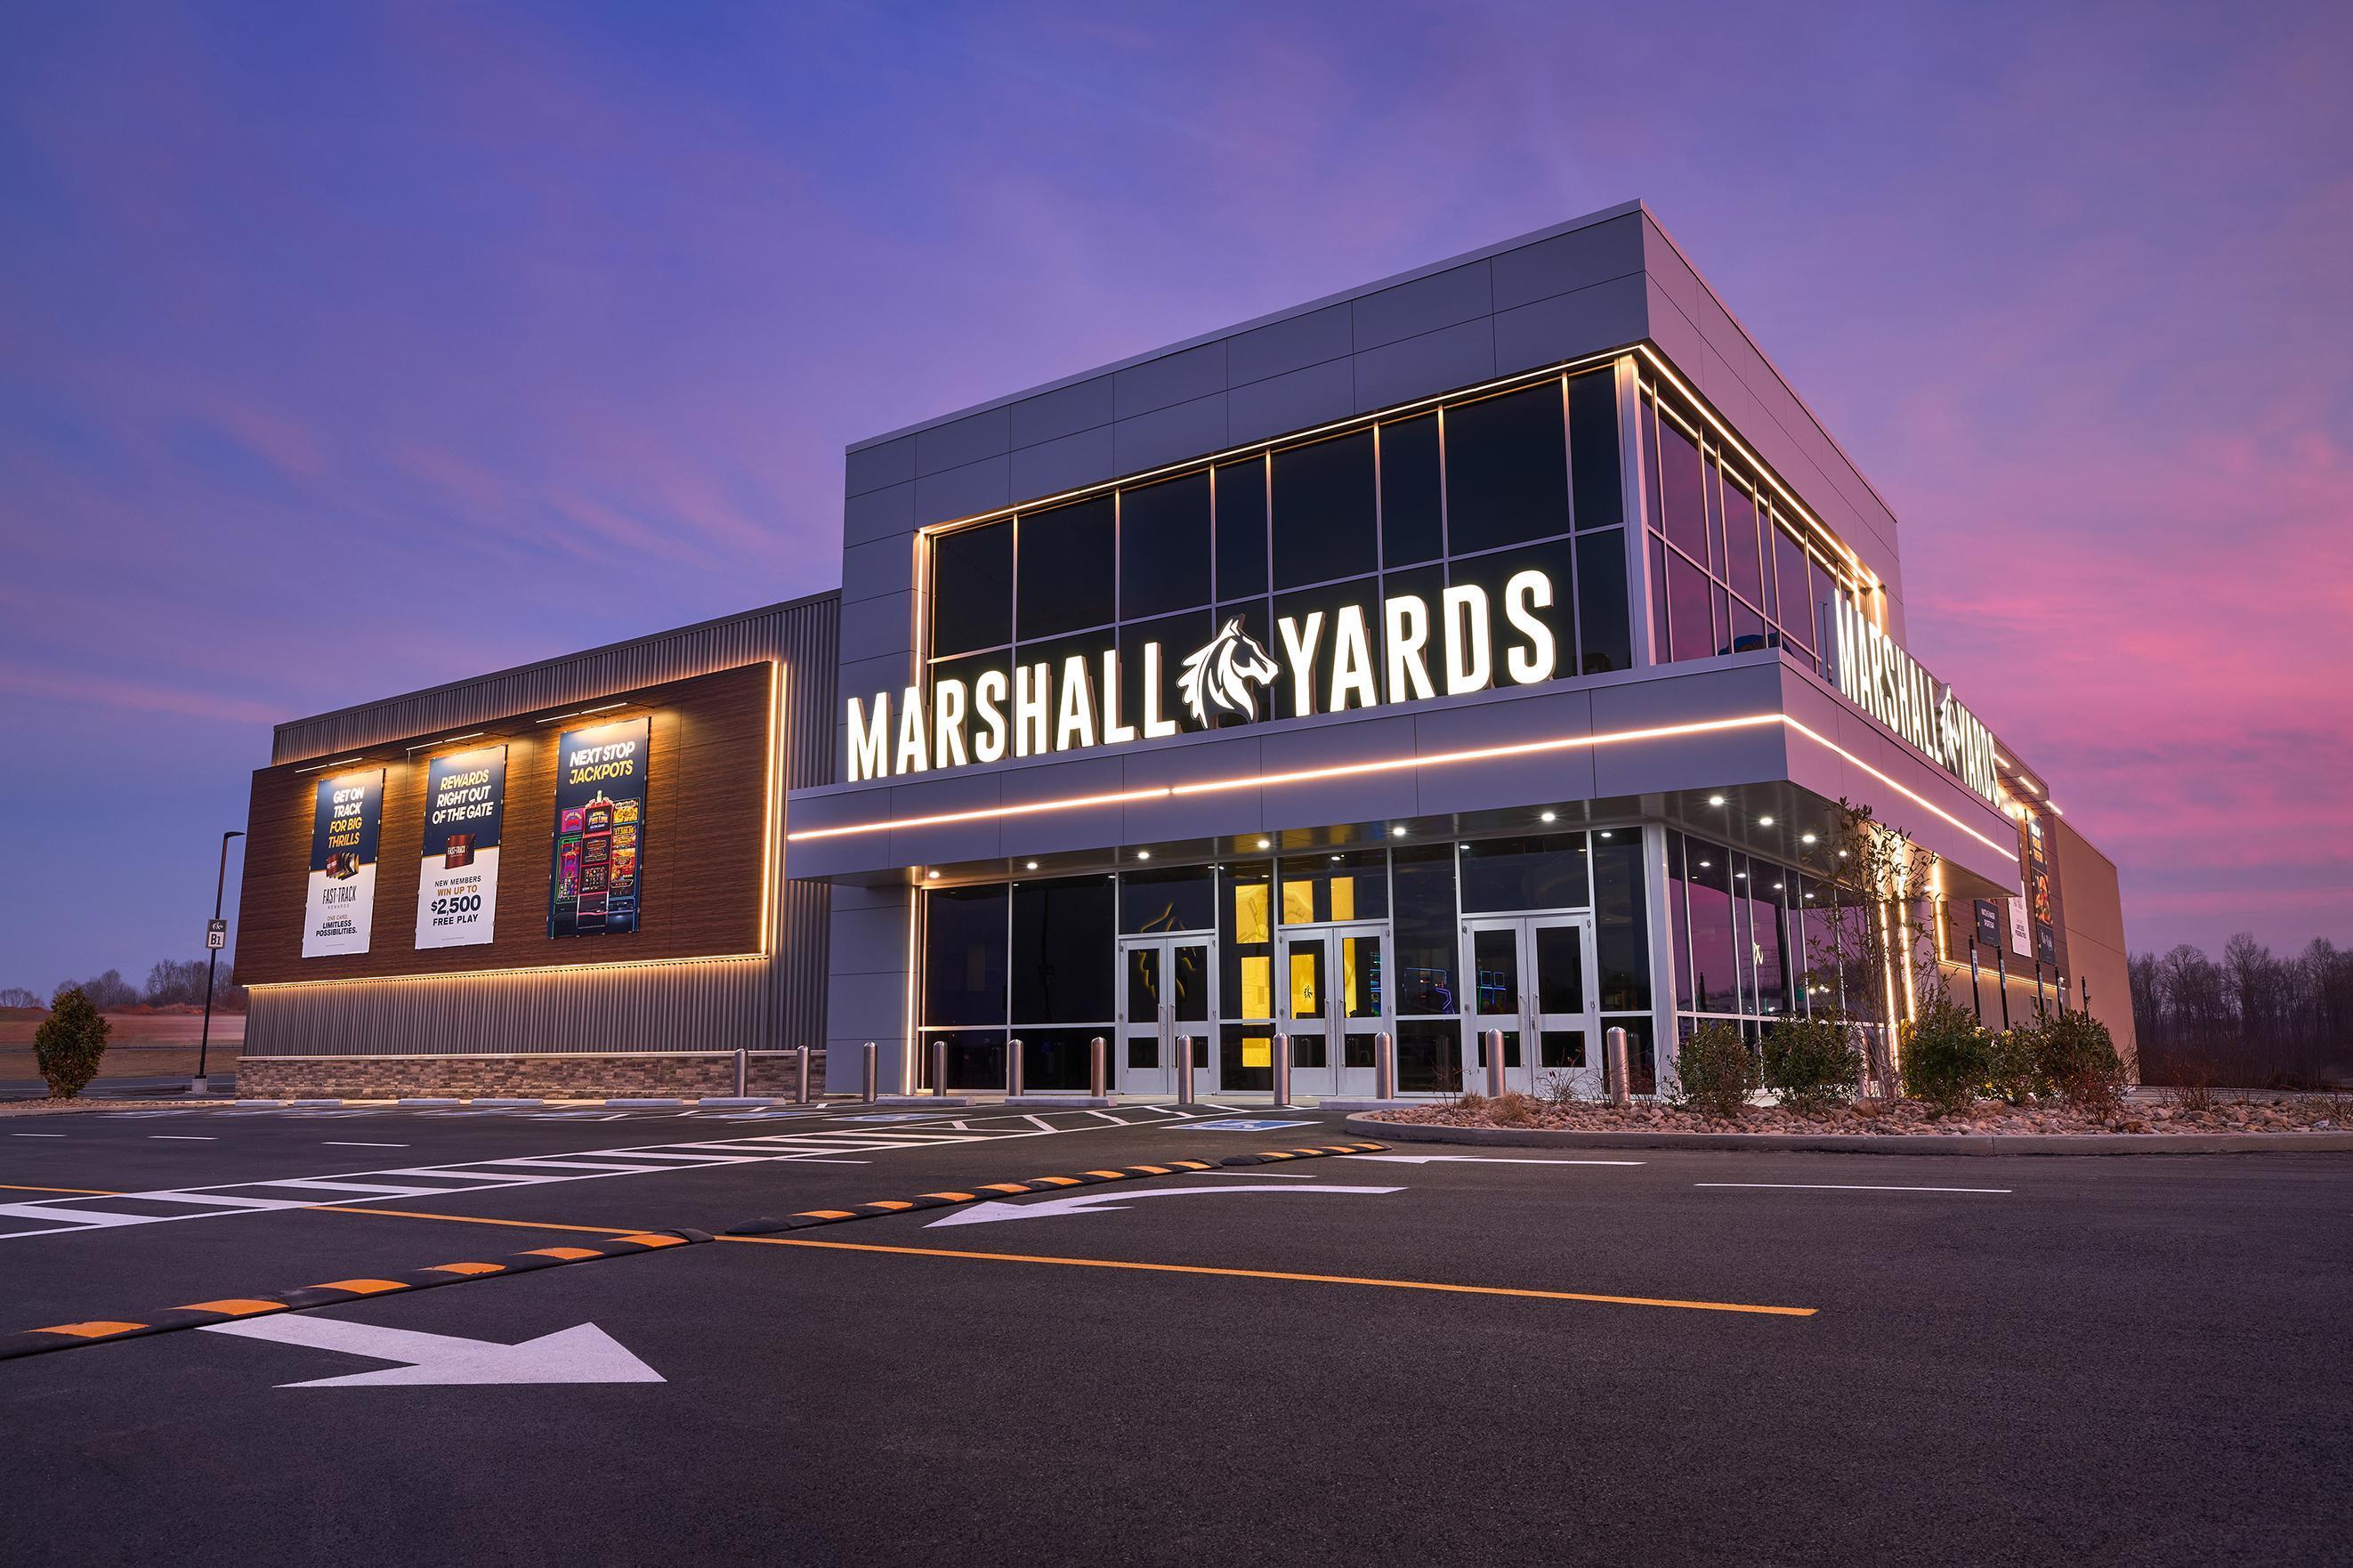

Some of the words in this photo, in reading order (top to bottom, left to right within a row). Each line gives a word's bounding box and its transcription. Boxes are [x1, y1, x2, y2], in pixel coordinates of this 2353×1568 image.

[847, 641, 1178, 783] MARSHALL
[1279, 570, 1556, 717] YARDS
[1834, 587, 1944, 766] MARSHALL
[1956, 700, 2001, 808] YARDS
[570, 746, 603, 767] NEXT
[602, 740, 635, 761] STOP
[441, 769, 489, 790] REWARDS
[570, 759, 634, 784] JACKPOTS
[333, 788, 352, 804] GET
[350, 786, 365, 801] ON
[436, 789, 469, 807] RIGHT
[468, 785, 491, 803] OUT
[334, 802, 363, 818] TRACK
[432, 810, 447, 825] OF
[447, 806, 467, 822] THE
[466, 802, 494, 819] GATE
[329, 820, 347, 834] FOR
[347, 816, 362, 830] BIG
[328, 832, 360, 848] THRILLS
[450, 876, 481, 885] MEMBERS
[437, 888, 451, 897] WIN
[454, 885, 465, 895] UP
[467, 885, 478, 893] TO
[431, 894, 481, 917] $2,500
[322, 920, 352, 929] LIMITLESS
[433, 917, 454, 926] FREE
[457, 914, 478, 924] PLAY
[210, 934, 221, 945] B1
[316, 927, 358, 937] POSSIBILITIES.
